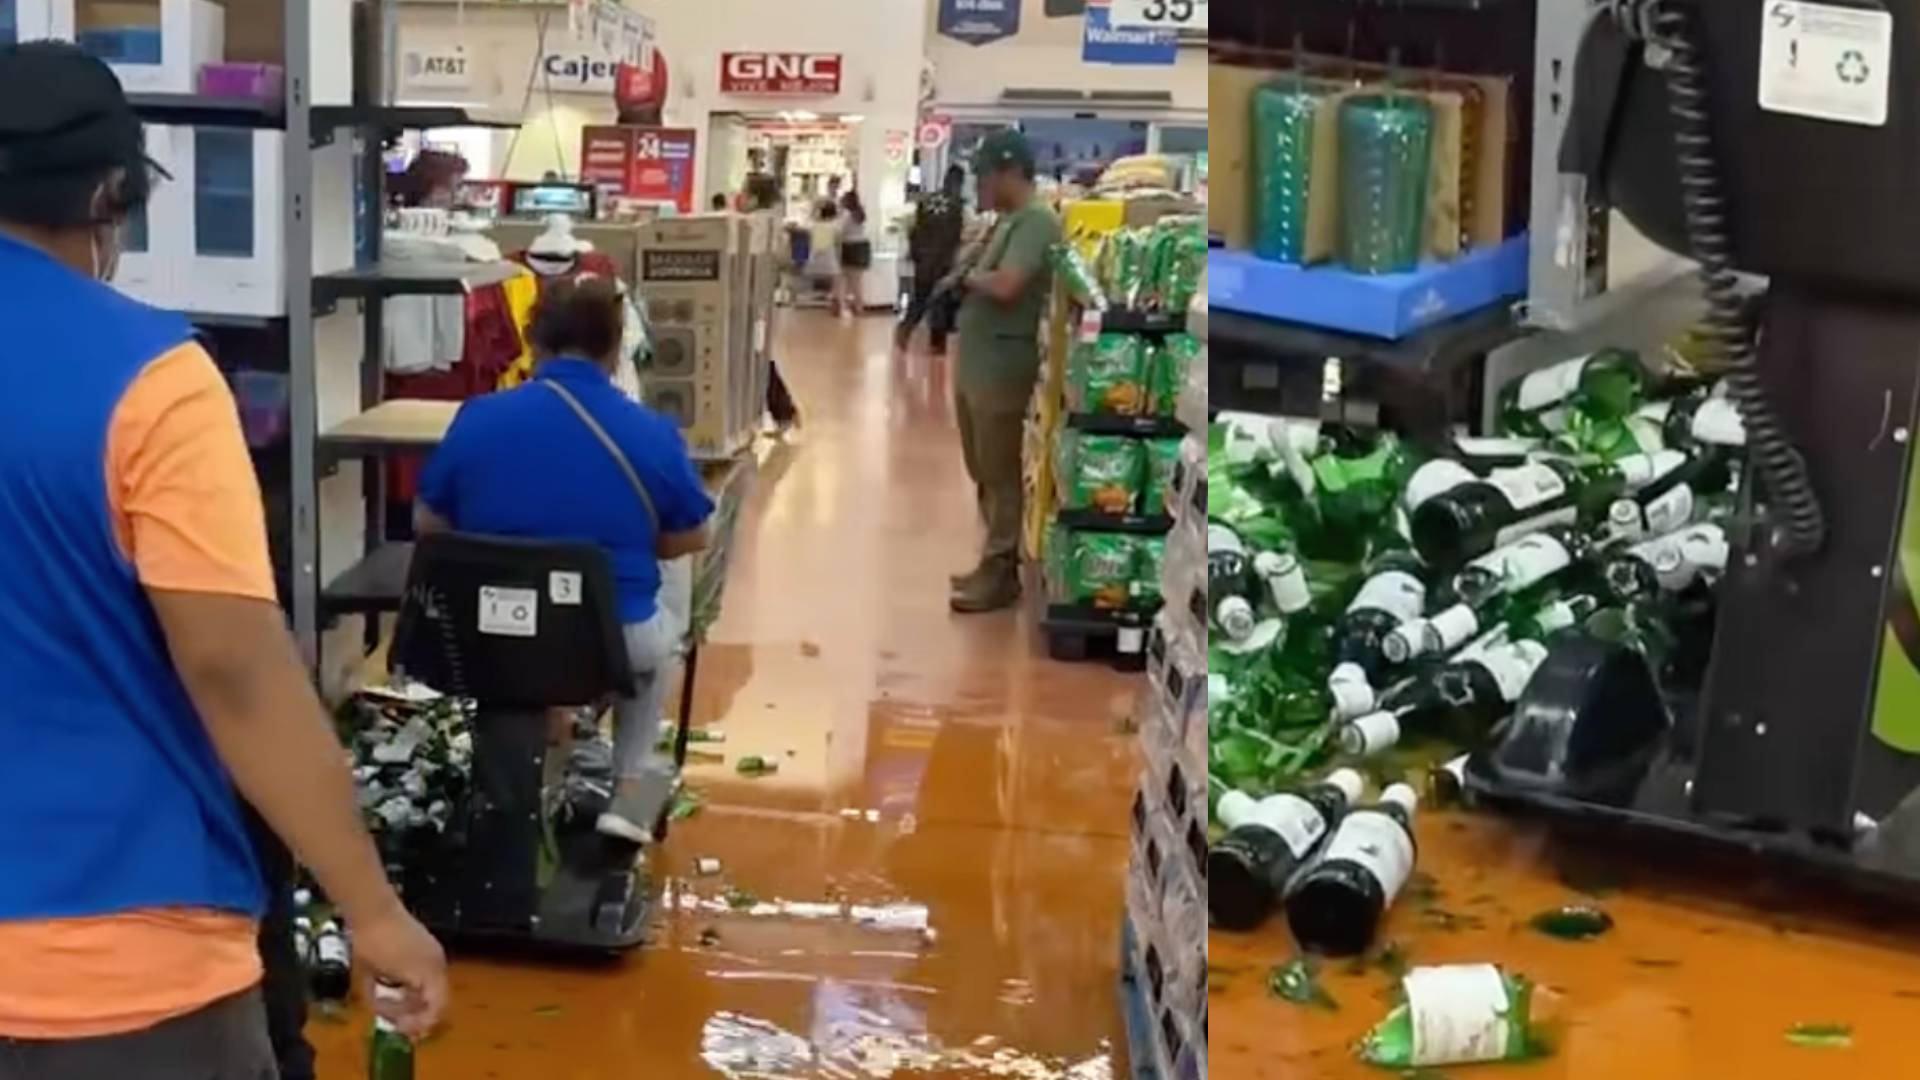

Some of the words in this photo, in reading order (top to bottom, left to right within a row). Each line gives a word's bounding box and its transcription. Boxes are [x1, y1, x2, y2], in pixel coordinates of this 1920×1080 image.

[1087, 27, 1155, 45] Walmart
[425, 57, 466, 75] AT&T
[729, 55, 836, 79] GNC
[558, 577, 571, 598] 3
